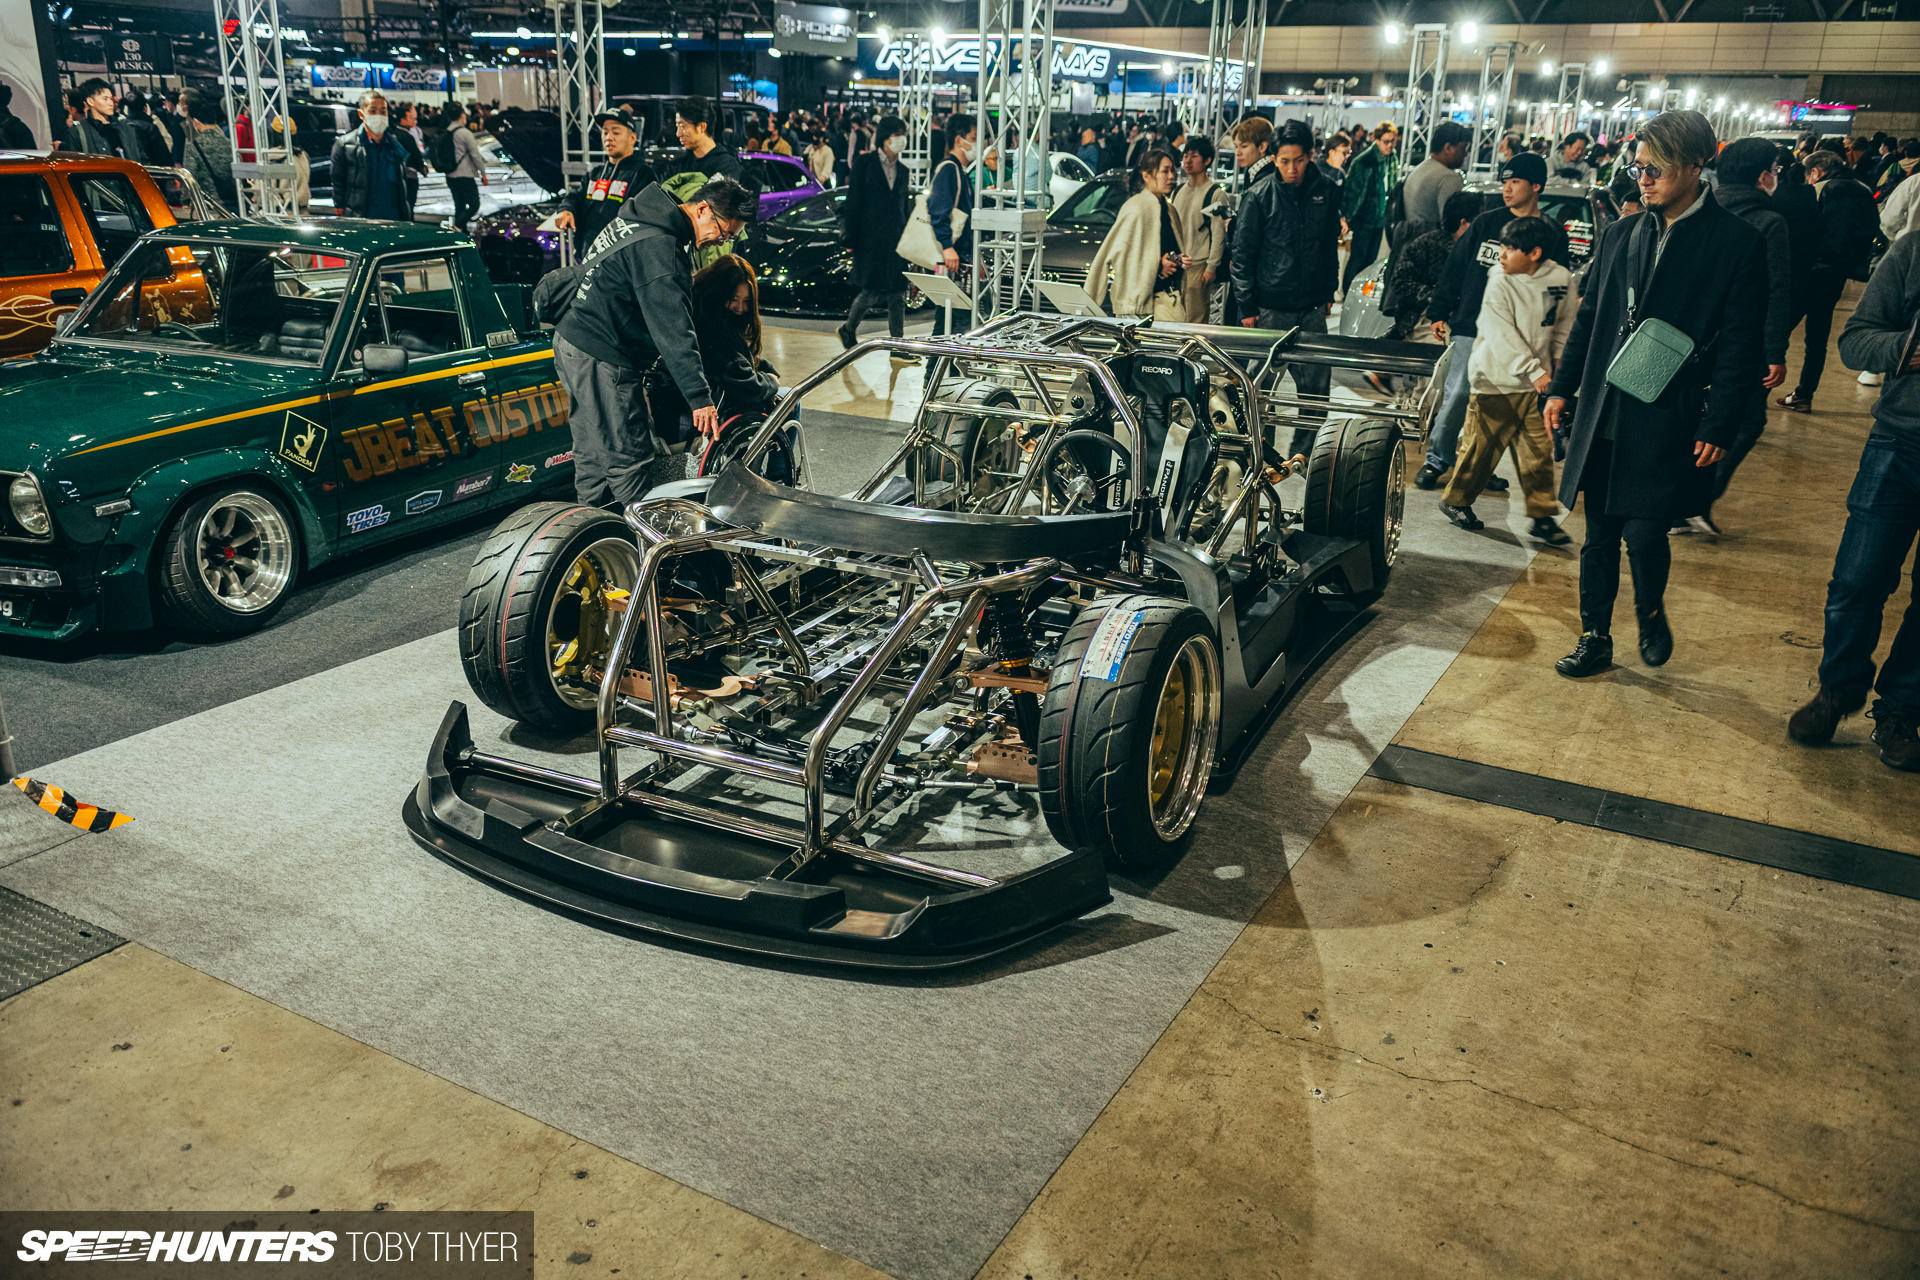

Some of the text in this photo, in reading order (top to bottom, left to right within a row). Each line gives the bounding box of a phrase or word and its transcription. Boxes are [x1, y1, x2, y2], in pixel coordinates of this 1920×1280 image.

[114, 61, 154, 71] DESIGN
[875, 41, 997, 72] RAYS
[321, 66, 367, 81] RAYS
[391, 68, 443, 84] RAYS
[1141, 365, 1173, 376] RECARO
[341, 405, 461, 482] JBEAT
[284, 448, 313, 467] PANDEM
[347, 504, 384, 526] TOYO
[352, 511, 391, 533] TIRES
